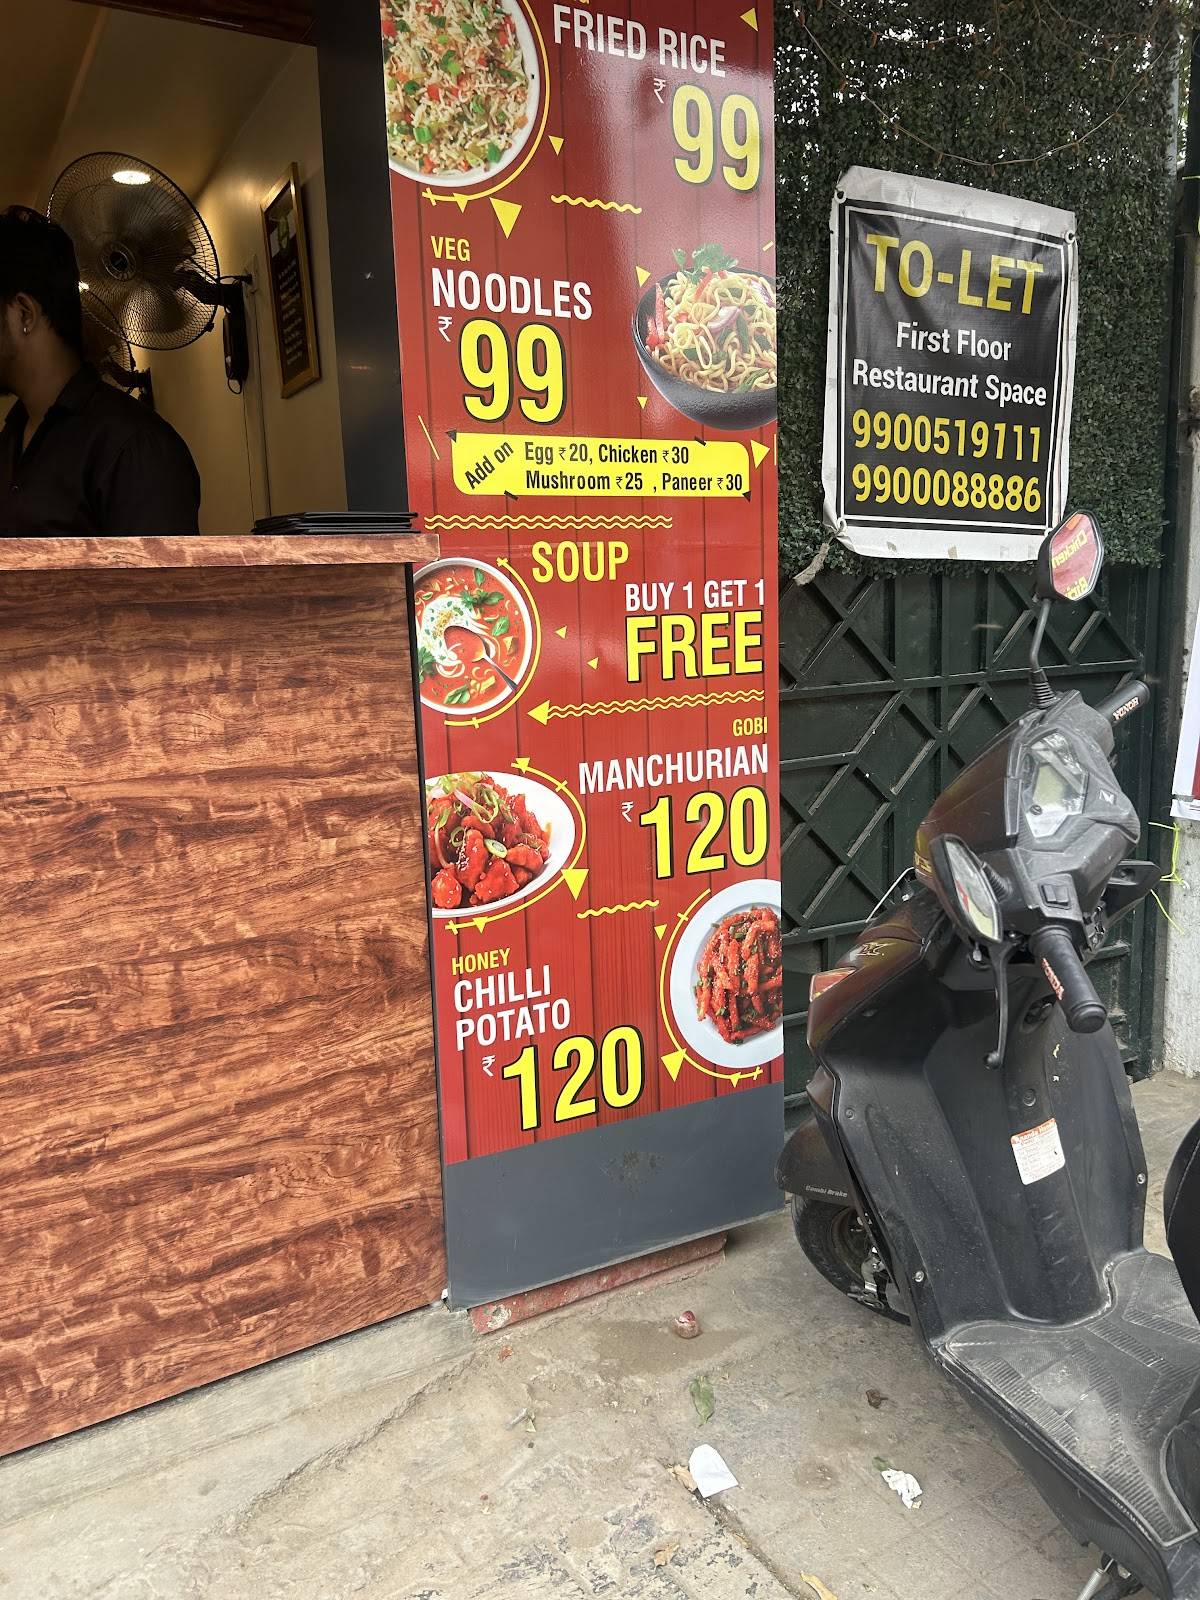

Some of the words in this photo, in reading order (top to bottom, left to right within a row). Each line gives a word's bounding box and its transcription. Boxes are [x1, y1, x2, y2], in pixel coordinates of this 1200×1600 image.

[553, 4, 647, 61] FRIED
[658, 27, 726, 78] RICE
[431, 236, 471, 262] VEG
[431, 268, 593, 321] NOODLES
[866, 233, 1044, 314] TO-LET
[896, 321, 950, 354] First
[957, 330, 1012, 361] Floor
[852, 359, 979, 399] Restaurant
[985, 377, 1047, 407] Space
[524, 442, 553, 465] Egg
[598, 444, 658, 464] Chicken
[851, 408, 1041, 462] 9900519111
[464, 457, 496, 489] Add
[493, 441, 514, 463] on
[525, 470, 611, 490] Mushroom
[662, 473, 713, 491] Paneer
[851, 463, 1041, 513] 9900088886
[531, 541, 629, 583] SOUP
[625, 581, 675, 612] BUY
[682, 581, 693, 609] 1
[703, 580, 748, 609] GET
[754, 579, 765, 606] 1
[625, 610, 764, 683] FREE
[732, 717, 768, 737] GOBI
[578, 743, 769, 795] MANCHURIAN
[451, 948, 511, 975] HONEY
[453, 965, 552, 1013] CHILLI
[455, 998, 571, 1051] POTATO
